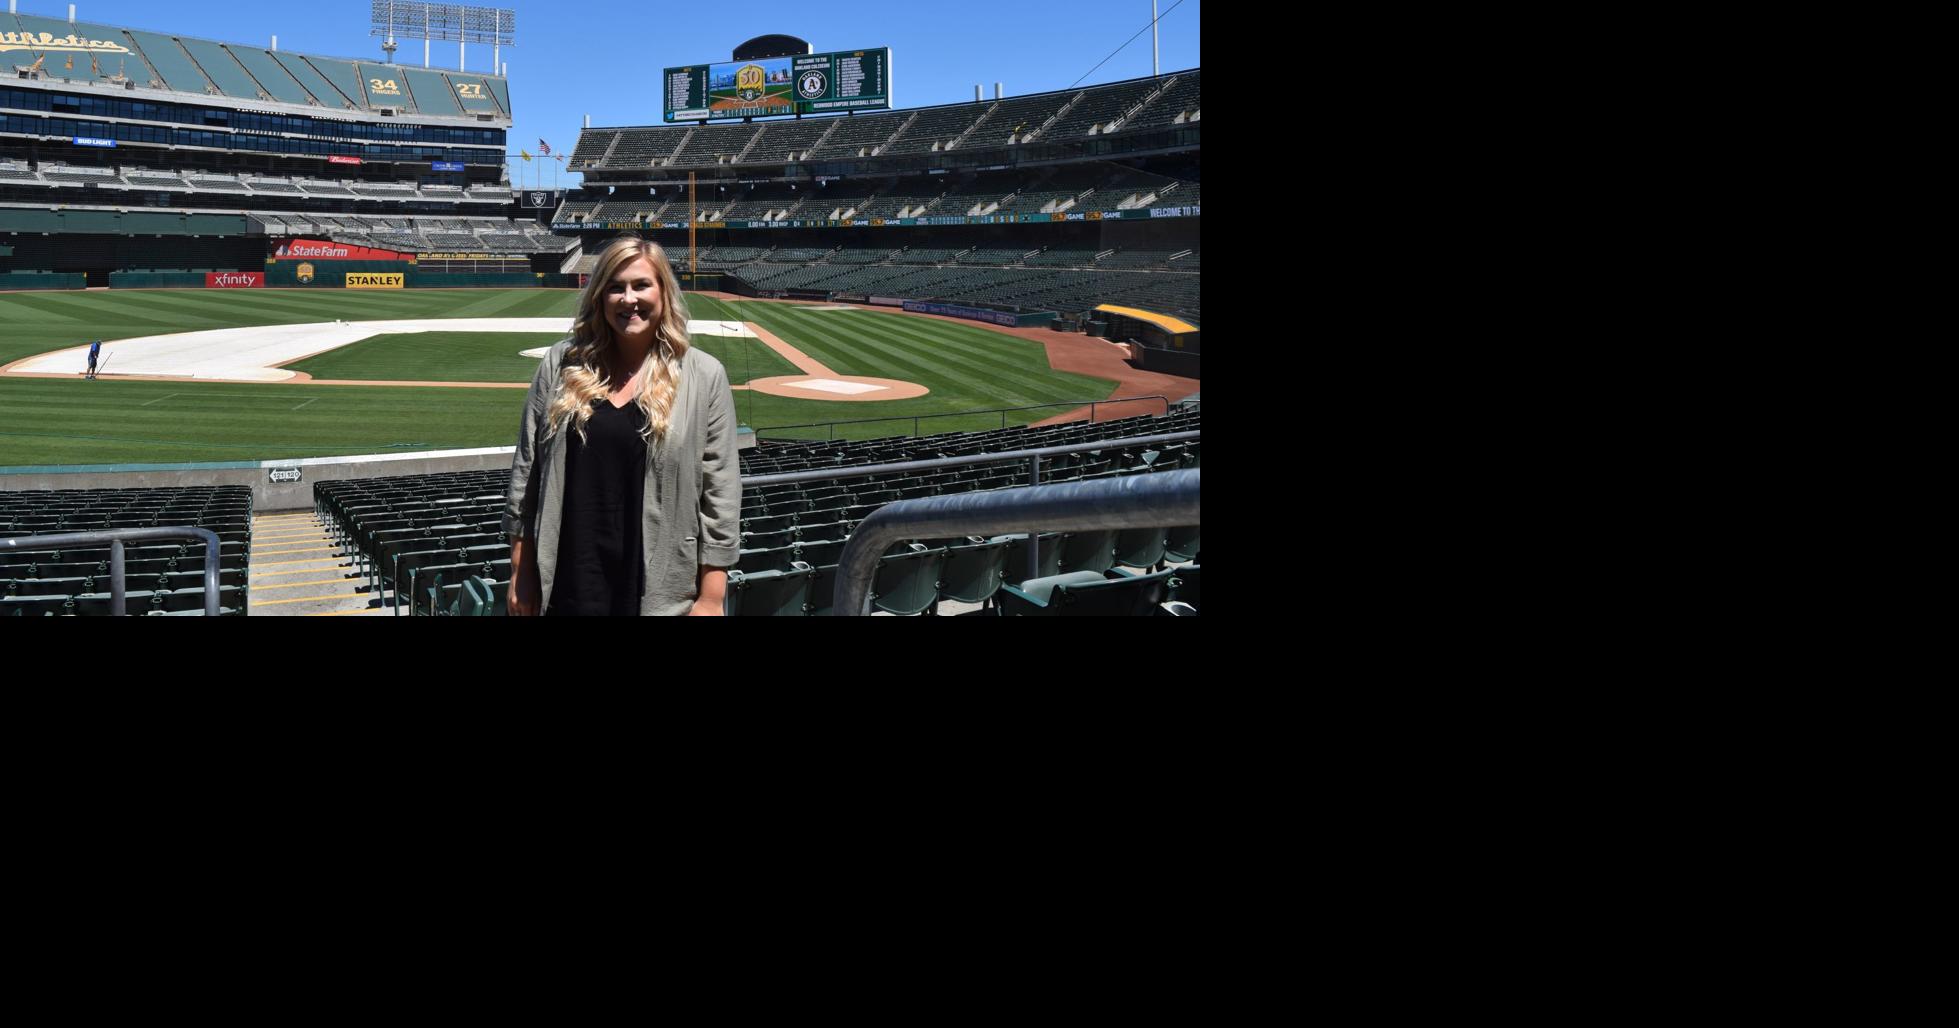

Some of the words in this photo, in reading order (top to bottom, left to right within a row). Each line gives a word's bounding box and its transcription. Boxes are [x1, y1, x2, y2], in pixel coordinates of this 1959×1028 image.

[0, 31, 124, 51] thletics
[741, 69, 761, 85] 50
[370, 79, 398, 91] 34
[456, 83, 482, 95] 27
[1150, 208, 1182, 218] WELCOME
[1183, 206, 1191, 216] TO
[215, 273, 256, 287] xfinity
[348, 276, 401, 285] STANLEY
[904, 302, 927, 311] GEICO
[996, 313, 1015, 326] GEICO
